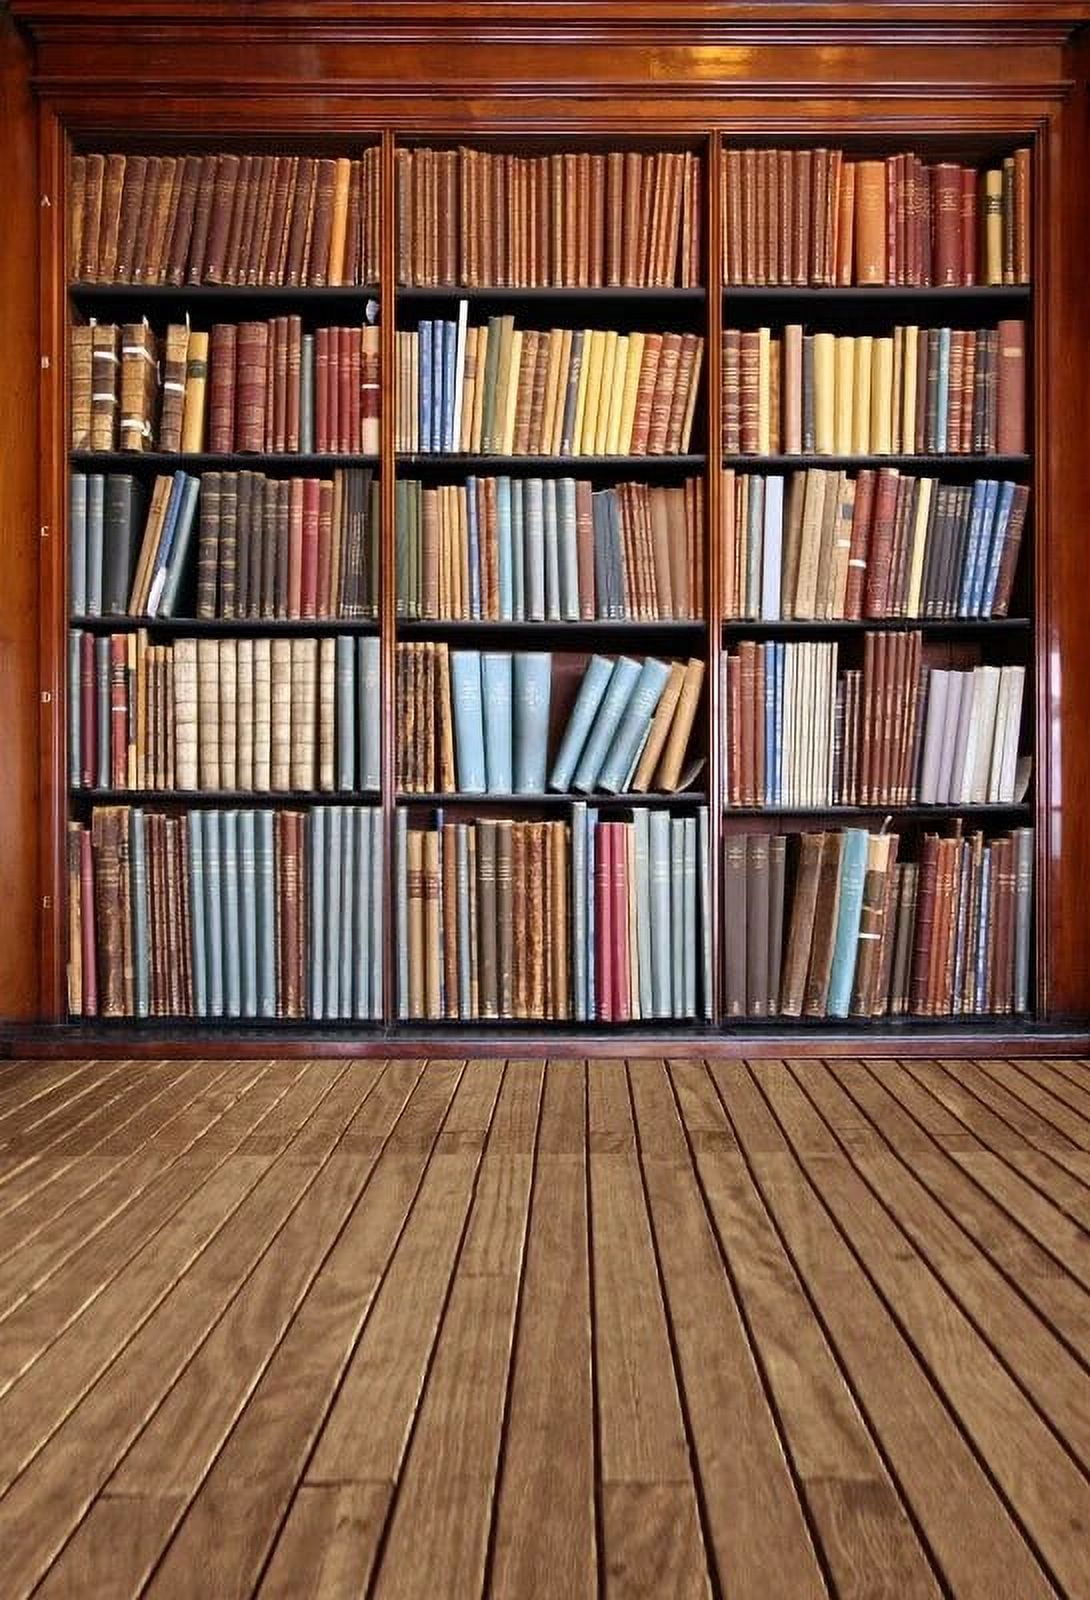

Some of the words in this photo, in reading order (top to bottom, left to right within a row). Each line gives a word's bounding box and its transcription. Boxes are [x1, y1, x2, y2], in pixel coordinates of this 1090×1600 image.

[41, 194, 51, 206] A
[41, 356, 50, 369] B
[40, 691, 51, 703] D
[43, 895, 51, 909] E
